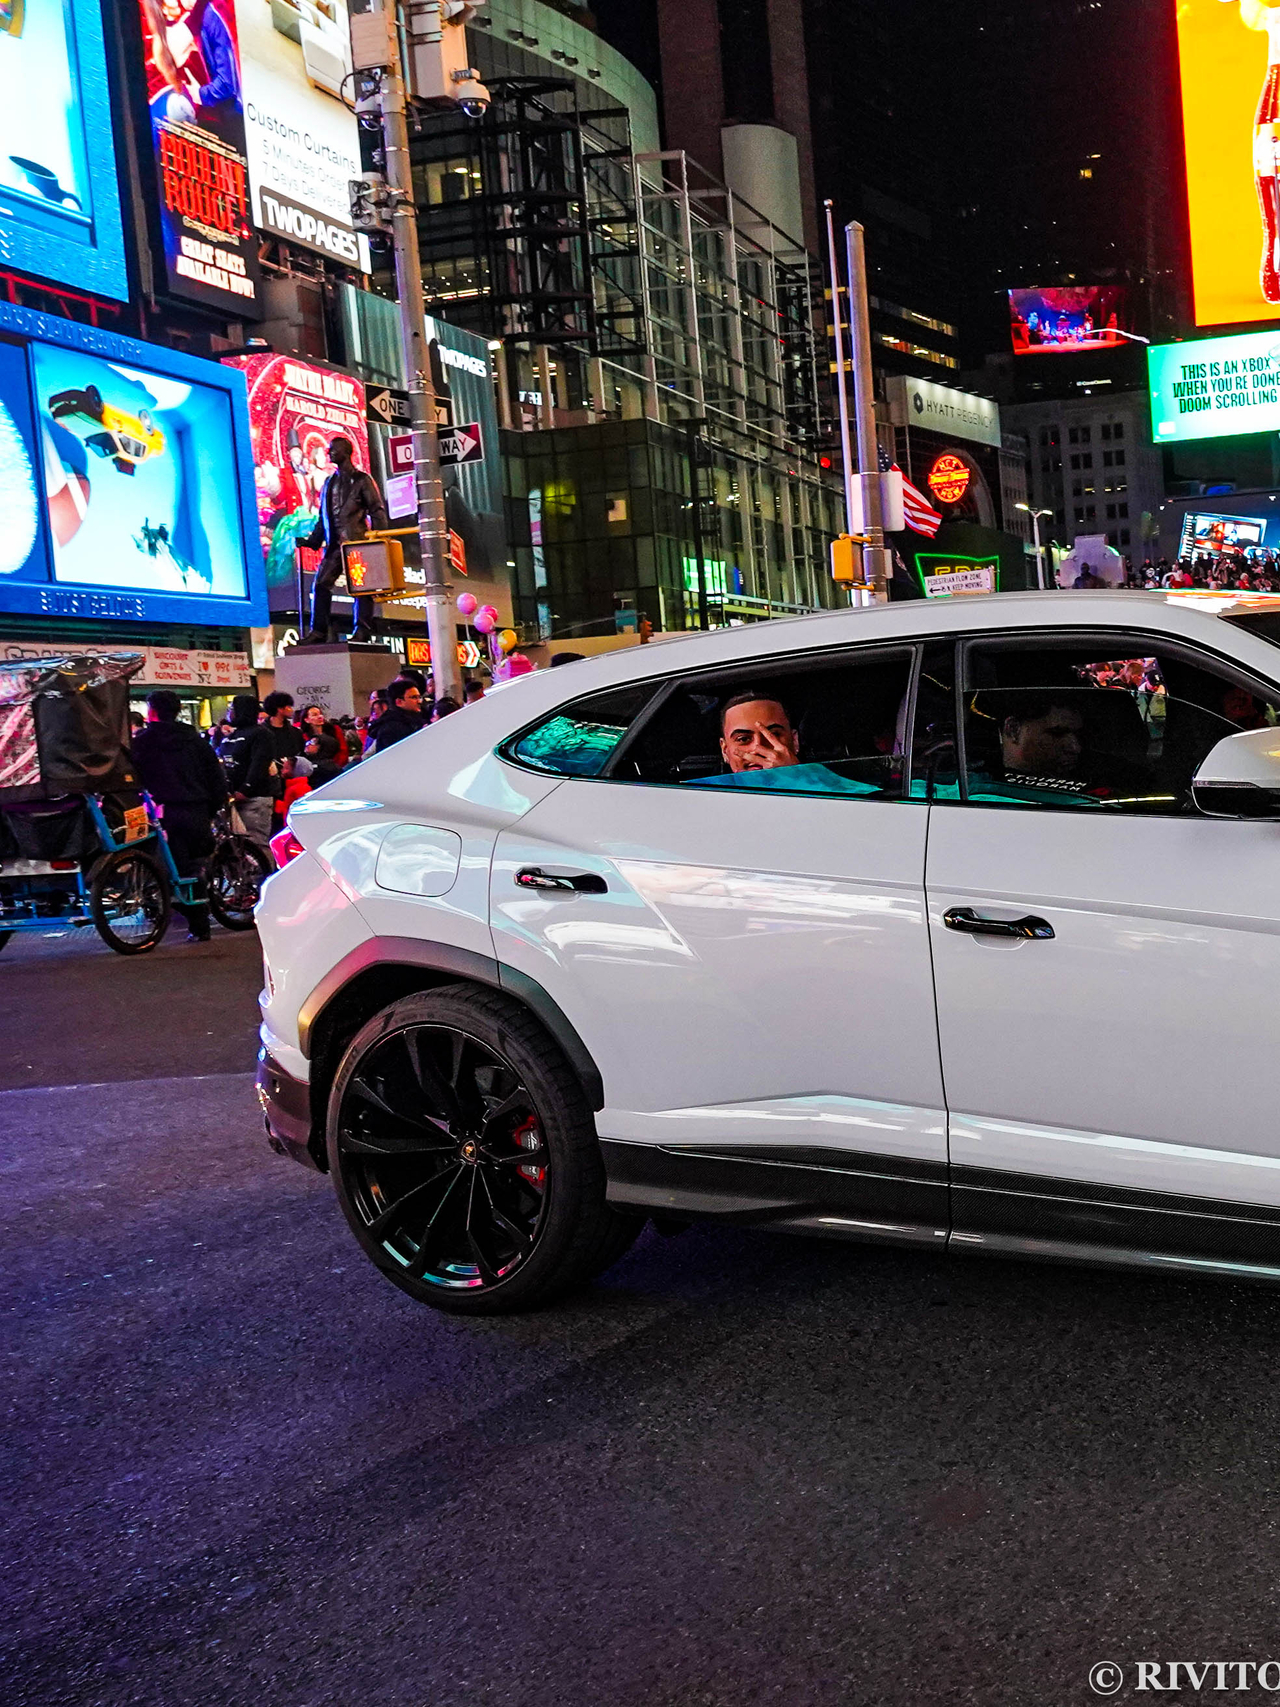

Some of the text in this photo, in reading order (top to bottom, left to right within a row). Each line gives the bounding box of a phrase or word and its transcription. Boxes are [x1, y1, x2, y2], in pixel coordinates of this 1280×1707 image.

[247, 102, 301, 144] Custom
[303, 133, 357, 174] Curtains
[262, 195, 359, 262] TWOPAGES
[437, 344, 487, 378] TWOPAGES
[1180, 356, 1271, 381] THIS IS AN XBOX
[1172, 380, 1208, 399] WHEN
[1252, 370, 1280, 389] DONE
[379, 398, 405, 416] ONE
[1178, 388, 1278, 414] DOOM SCROLLING
[926, 400, 995, 429] HYATT REGENCY
[440, 437, 467, 455] WAY
[927, 572, 982, 586] PEDESTRIAN FLOW ZONE
[964, 581, 983, 590] MOVING
[296, 685, 332, 696] GEORGE
